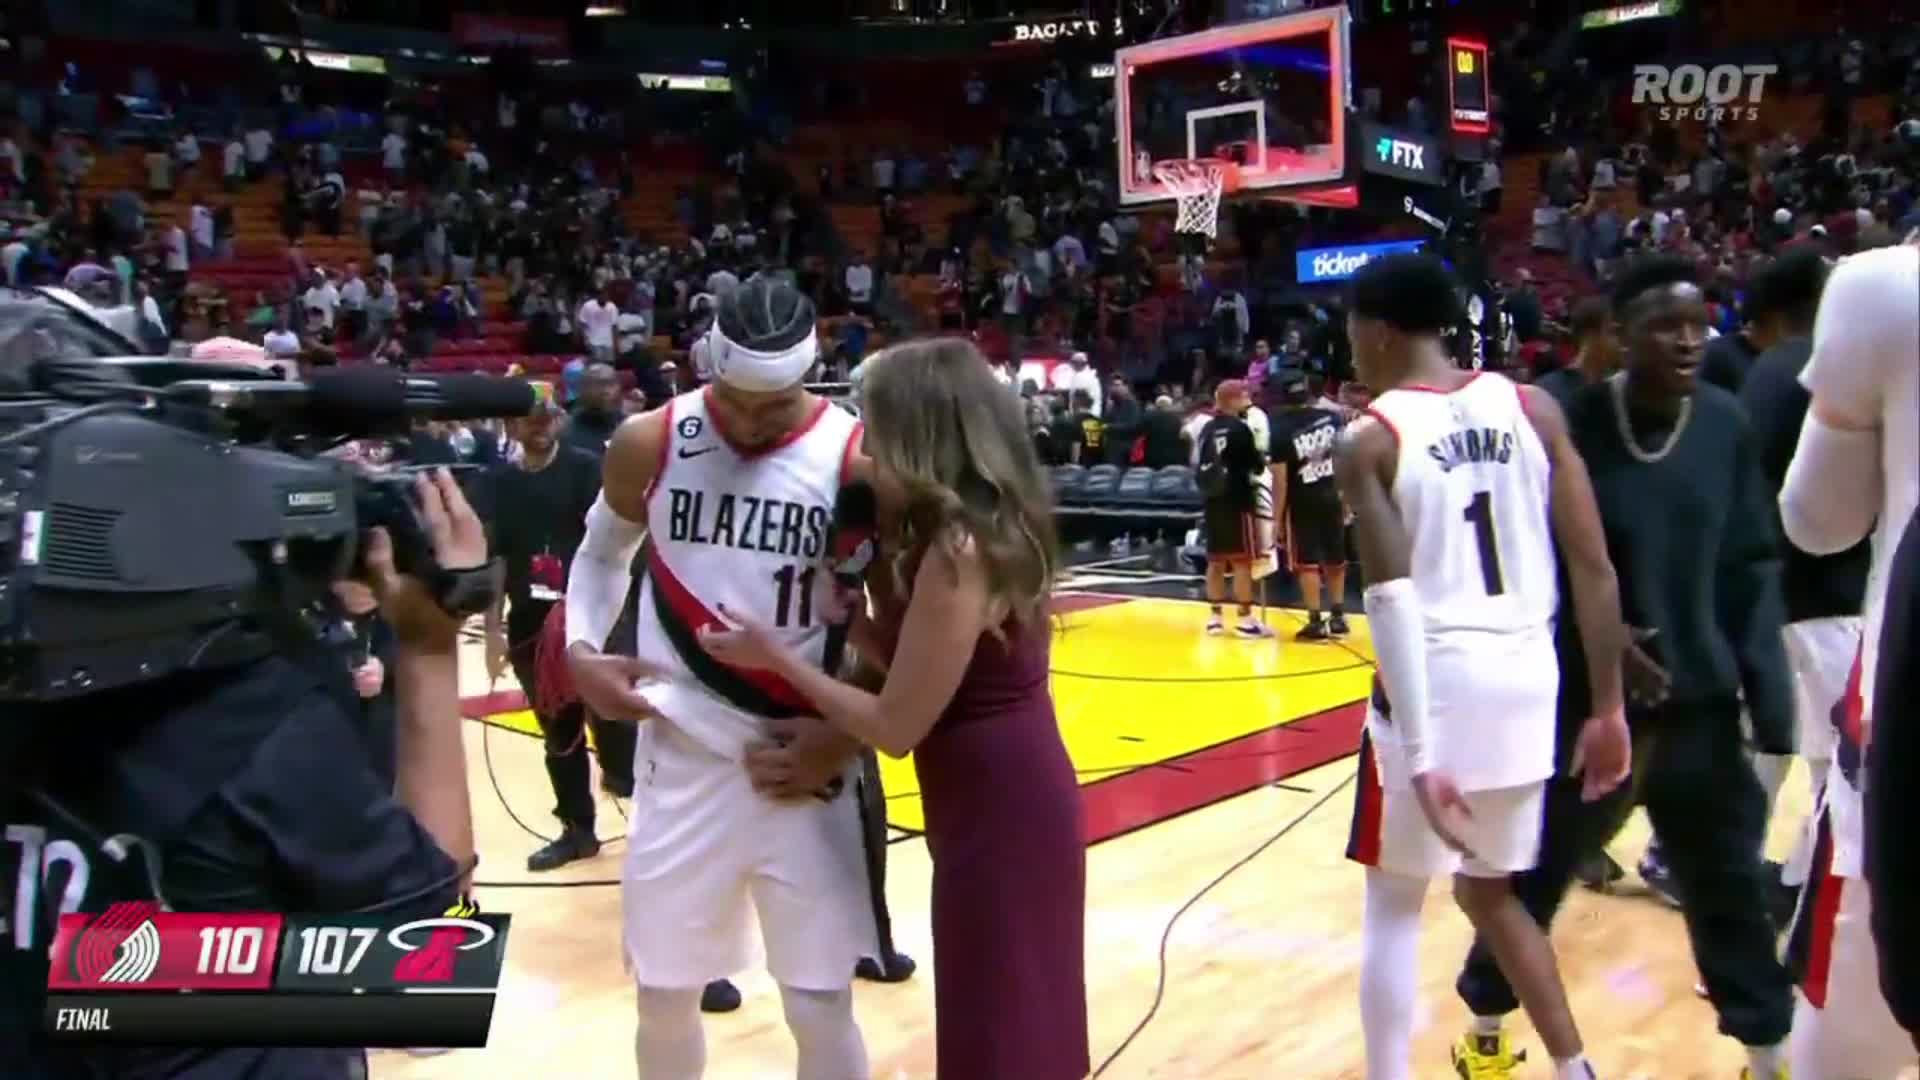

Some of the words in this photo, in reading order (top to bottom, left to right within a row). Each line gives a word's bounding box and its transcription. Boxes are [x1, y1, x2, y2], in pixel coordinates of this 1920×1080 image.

[1392, 139, 1424, 169] FTX
[1428, 427, 1513, 474] SIMONS
[669, 487, 827, 558] BLAZERS
[1464, 490, 1505, 597] 1
[773, 564, 817, 628] 11
